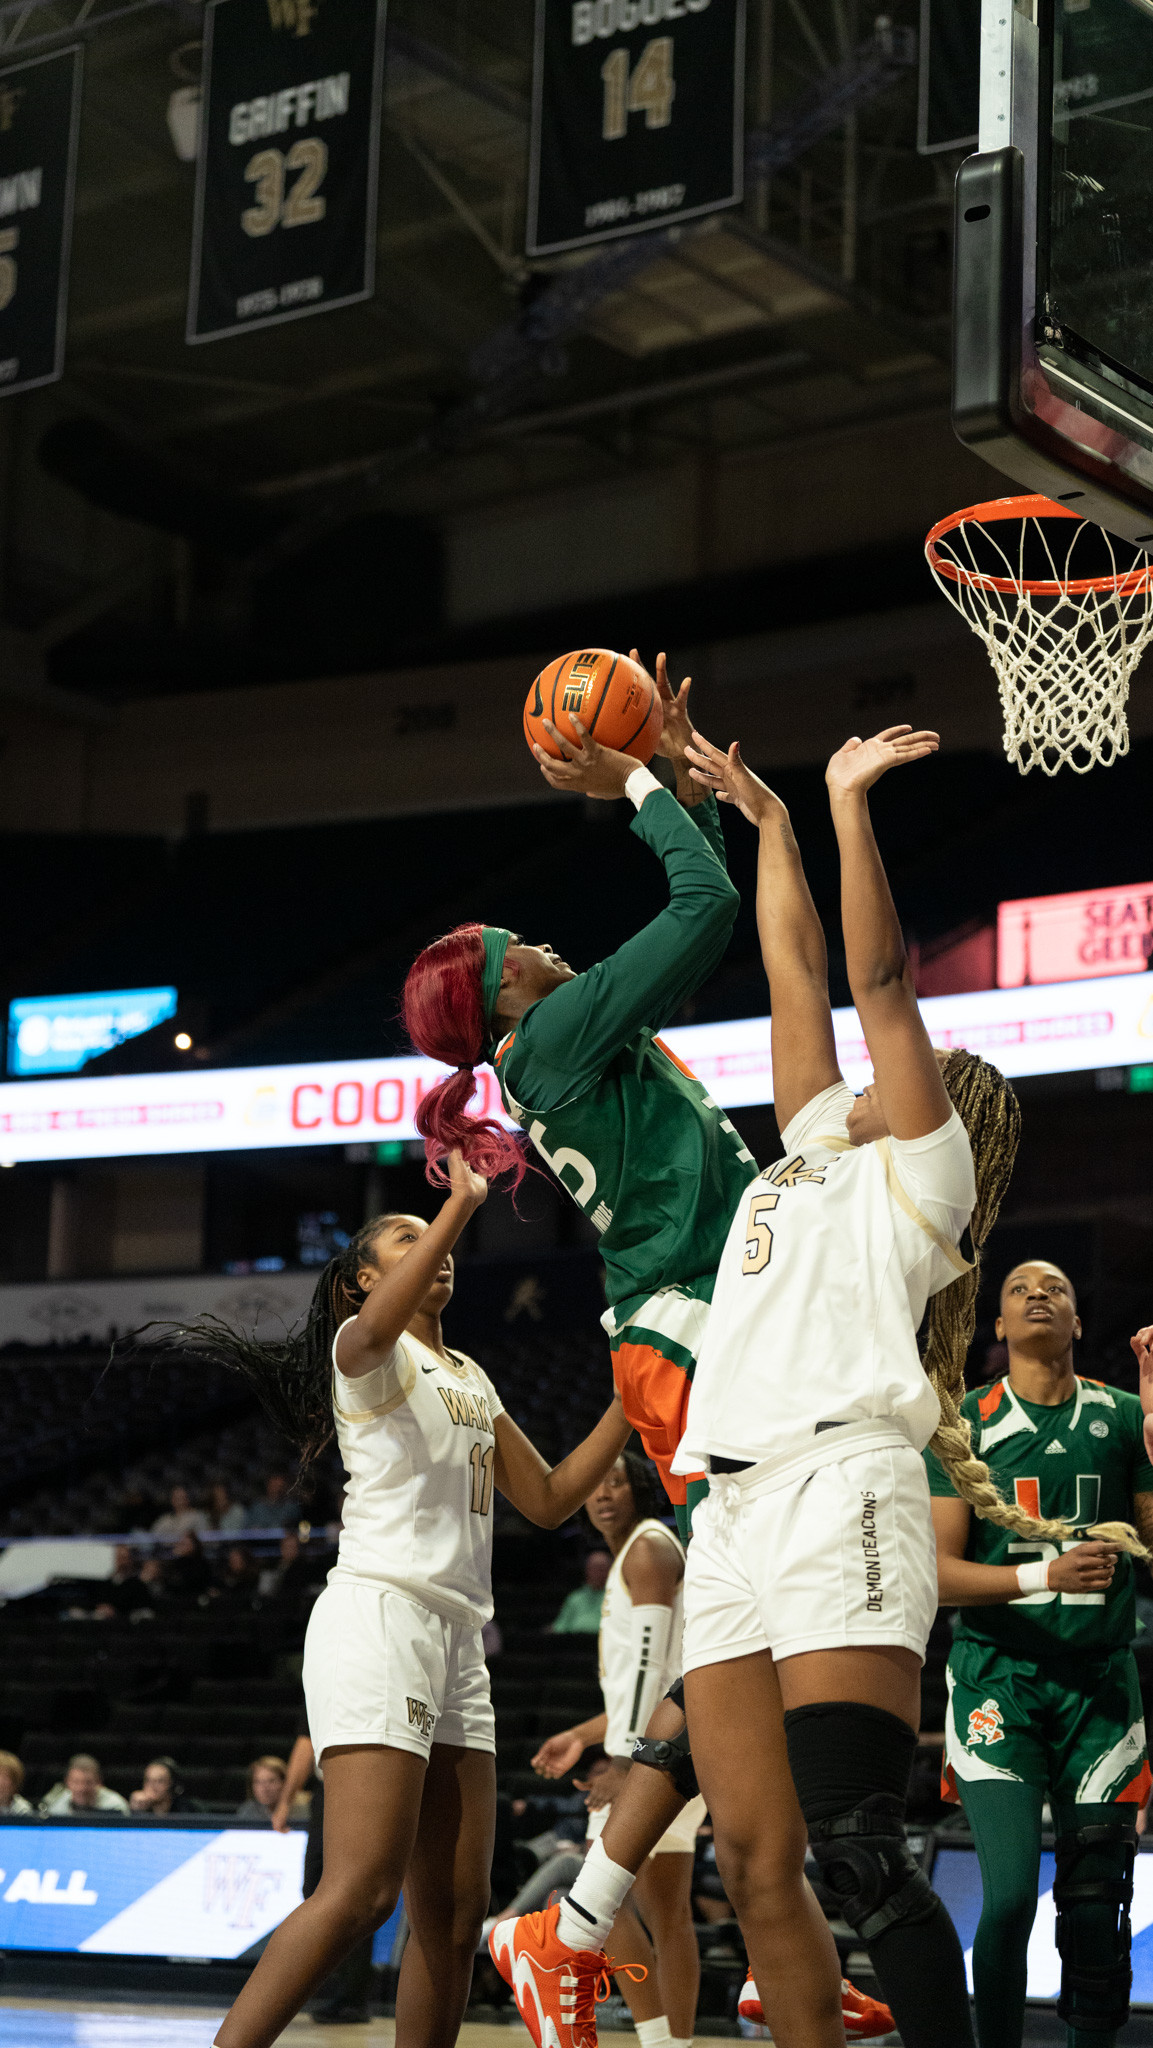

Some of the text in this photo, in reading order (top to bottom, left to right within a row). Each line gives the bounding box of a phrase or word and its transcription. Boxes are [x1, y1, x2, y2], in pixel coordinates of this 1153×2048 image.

[228, 72, 350, 146] GRIFFIN
[601, 36, 675, 140] 14
[240, 137, 329, 237] 32
[562, 653, 600, 712] ELITE
[742, 1193, 780, 1275] 5
[469, 1442, 494, 1516] 11
[860, 1491, 883, 1612] DEMON DEACONS
[405, 1695, 436, 1737] WF
[3, 1869, 98, 1905] ALL
